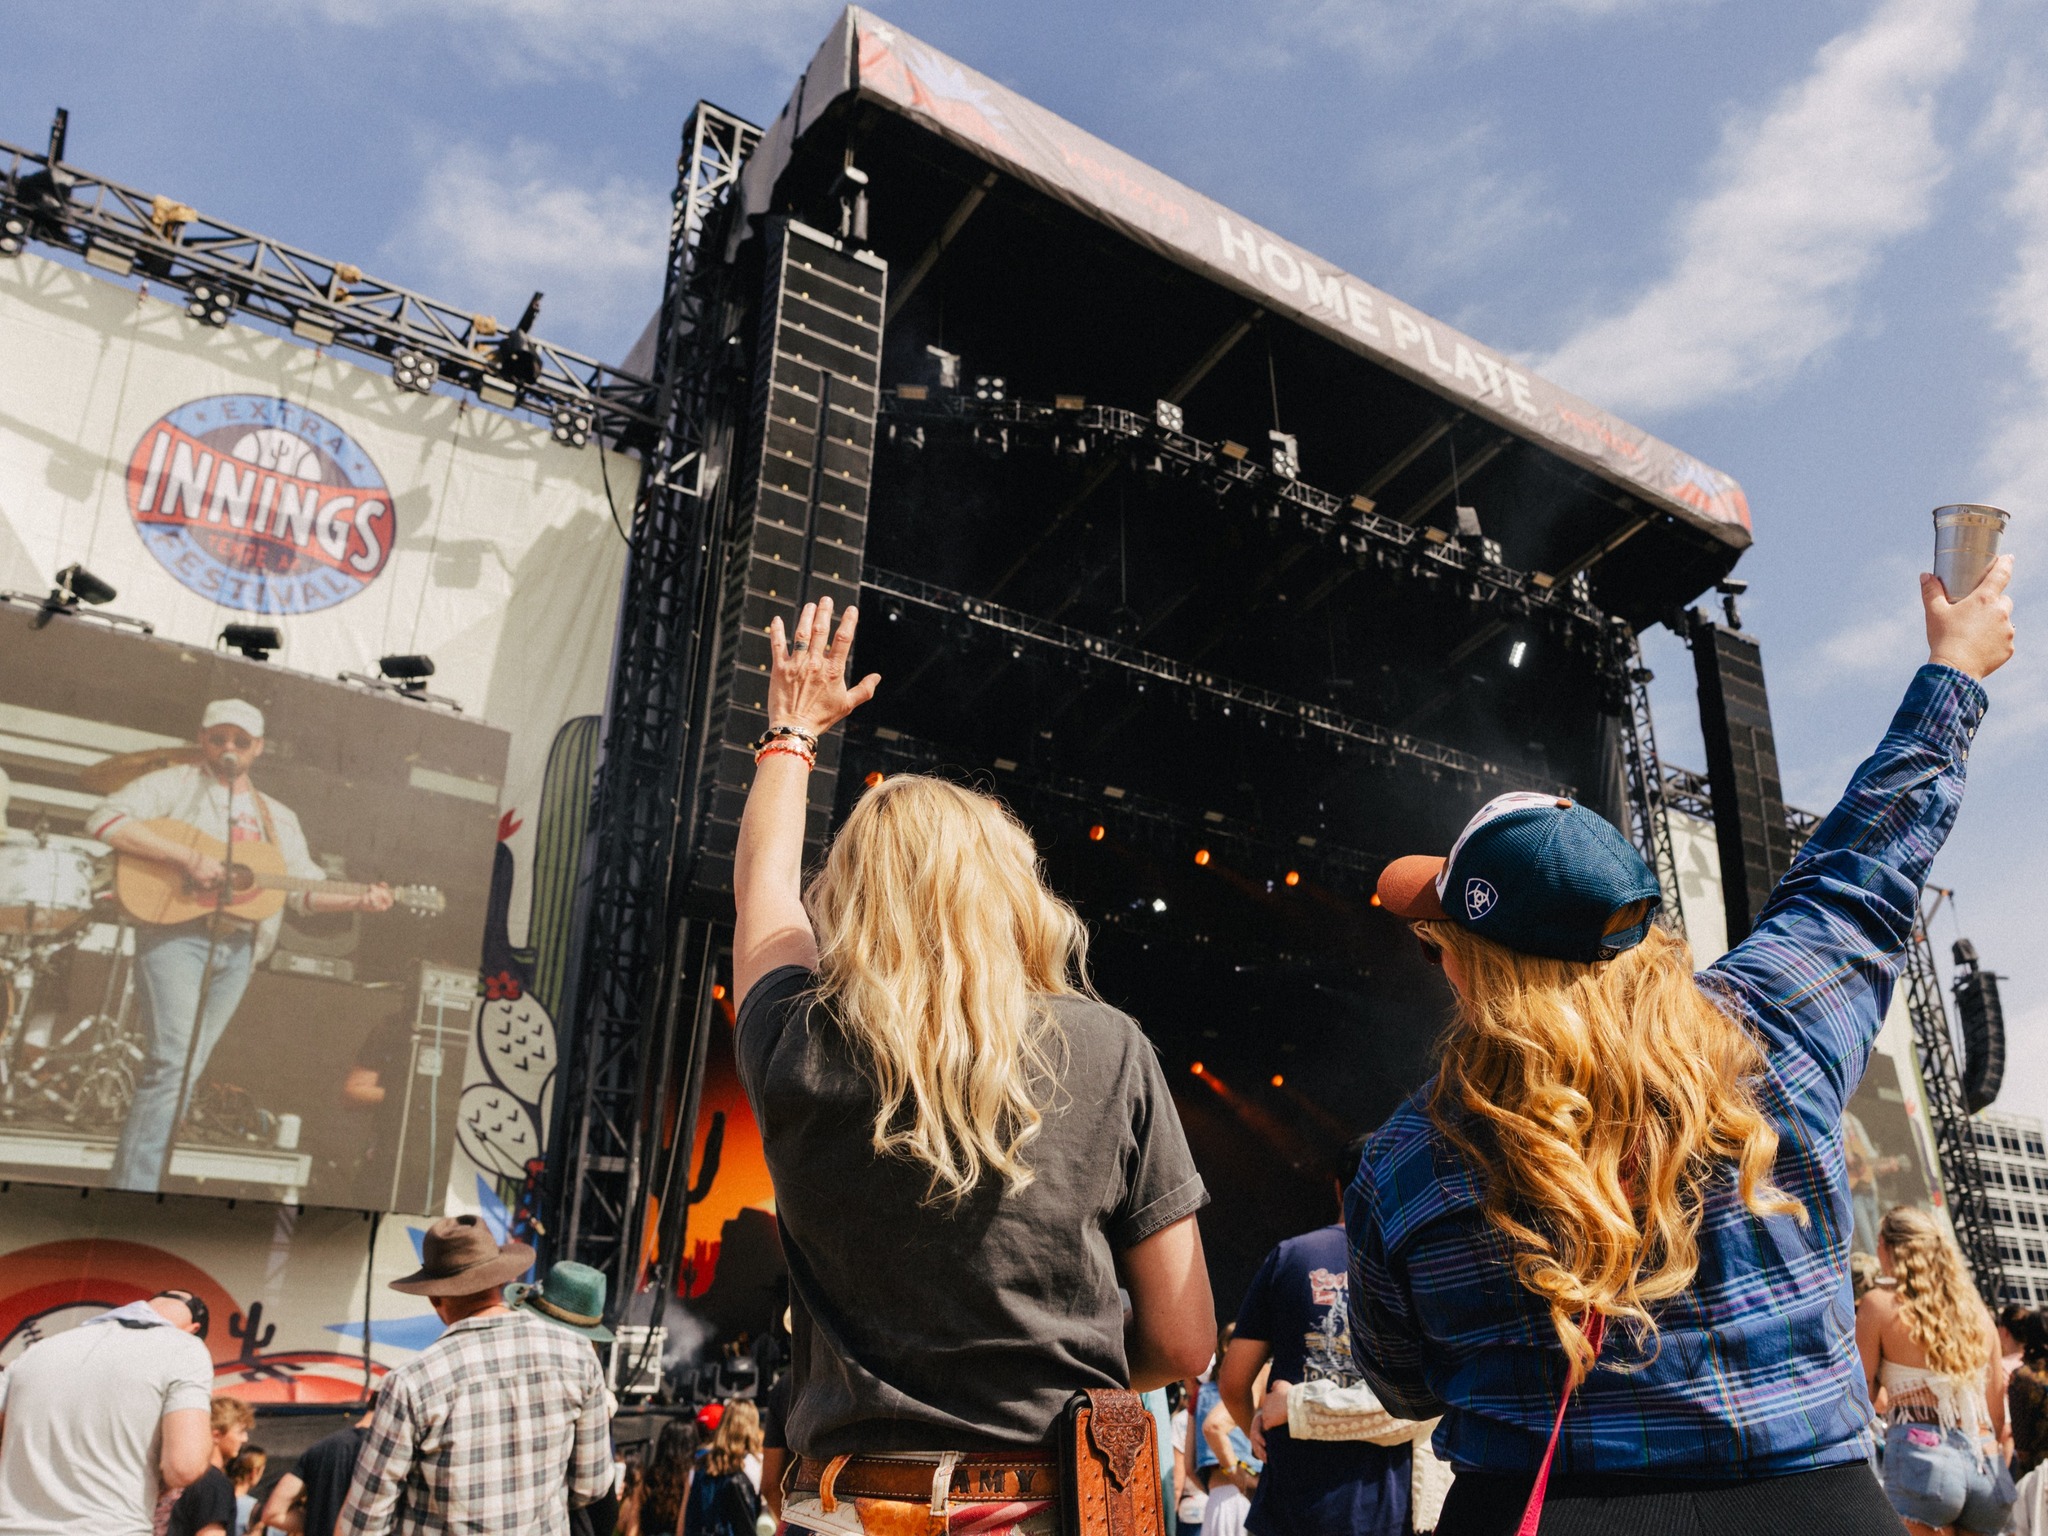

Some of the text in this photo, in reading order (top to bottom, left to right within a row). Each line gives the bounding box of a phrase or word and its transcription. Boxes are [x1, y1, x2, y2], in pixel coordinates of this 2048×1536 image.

[1217, 215, 1539, 418] HOME PLATE
[220, 400, 344, 455] EXTRA
[137, 430, 386, 573] INNINGS
[154, 529, 349, 608] FESTIVAL
[947, 1468, 1038, 1494] AMY
